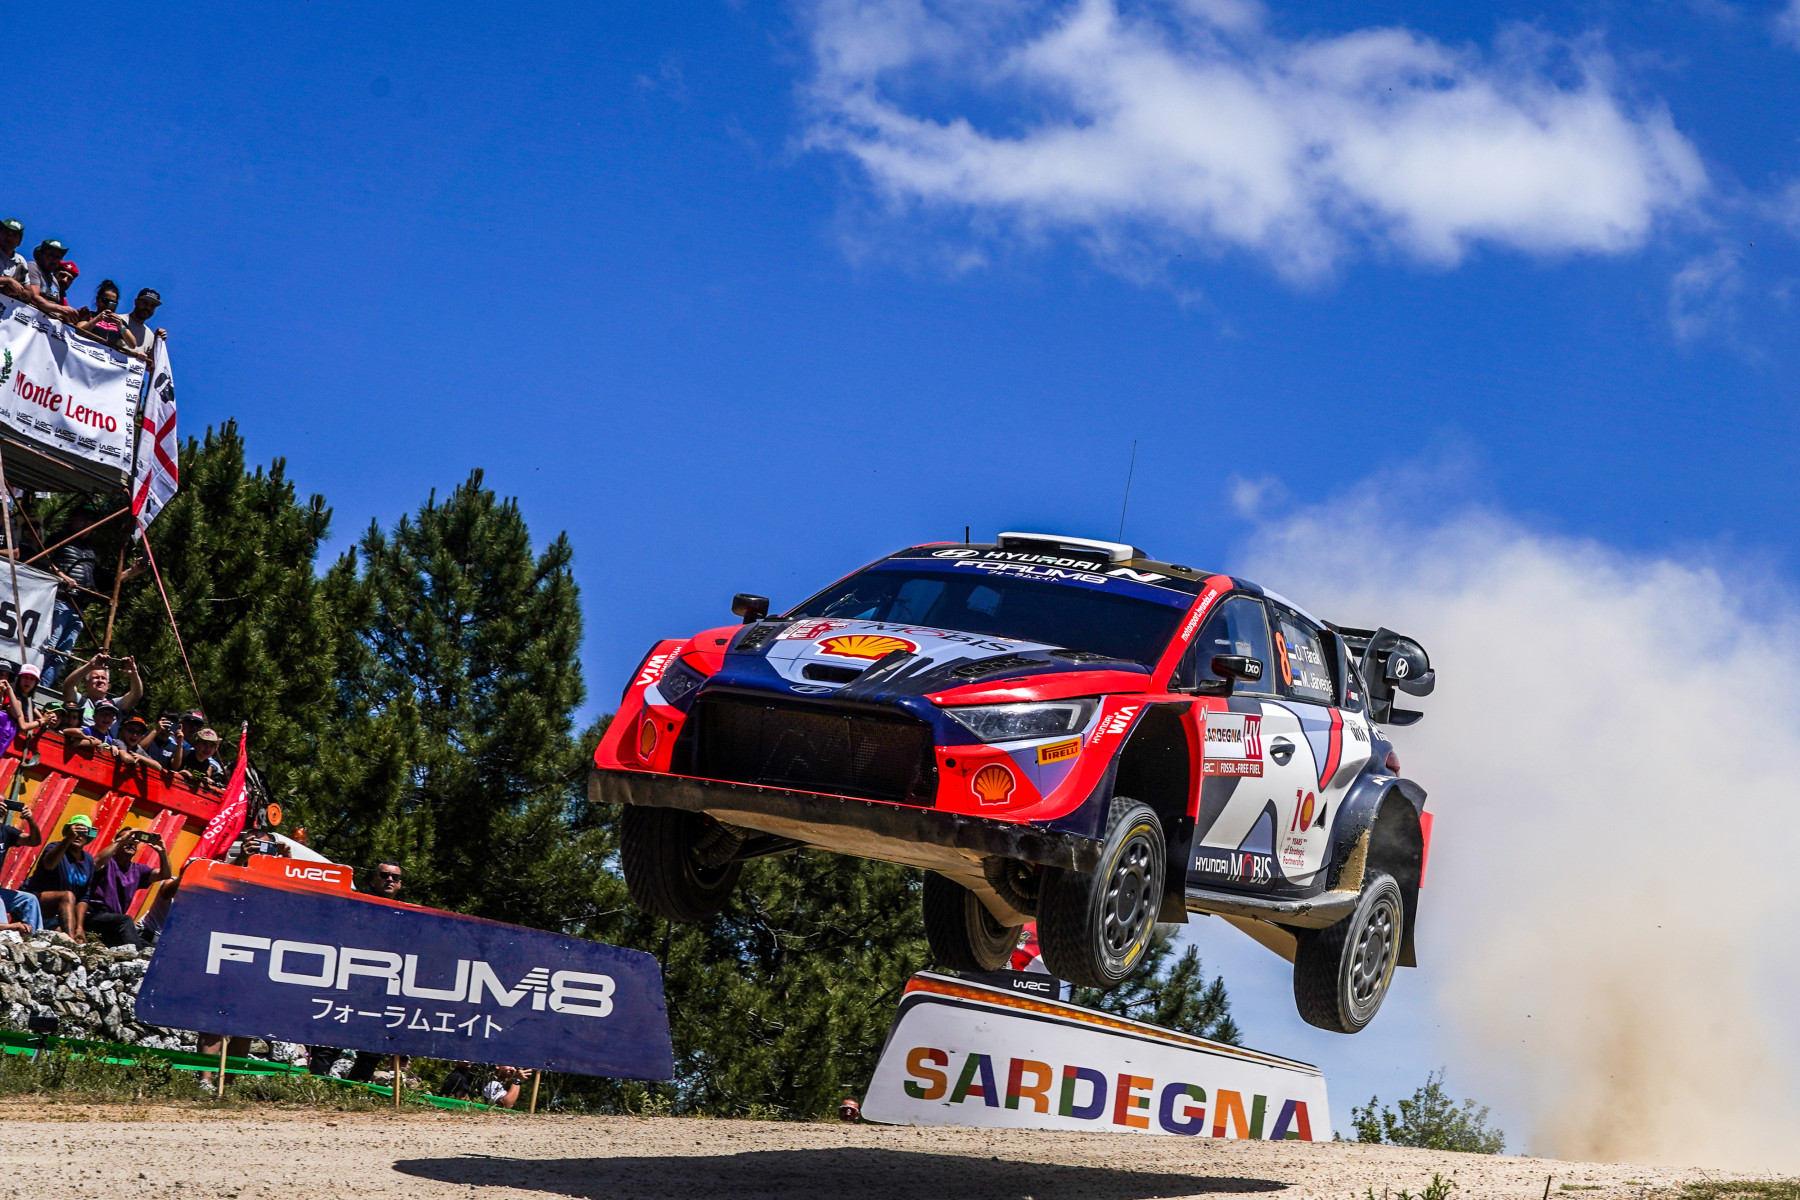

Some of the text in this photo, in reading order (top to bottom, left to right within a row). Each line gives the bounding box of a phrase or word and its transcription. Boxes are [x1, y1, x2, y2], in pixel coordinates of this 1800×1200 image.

[13, 370, 116, 432] Monte Lerno
[55, 427, 77, 440] WRC
[78, 435, 97, 448] WRC
[99, 443, 121, 454] WRC
[953, 560, 1108, 584] FORUM8
[984, 551, 1101, 571] HYUNDAI
[1181, 589, 1218, 641] motorsport.hyundai.com
[1245, 659, 1260, 675] ixo
[1275, 631, 1292, 686] 8
[1092, 715, 1114, 744] HYUNDAI
[1106, 706, 1139, 734] WIA
[1041, 741, 1078, 761] PIRELLI
[1203, 762, 1261, 775] RC FOSSIL-FREE FUEL
[1291, 789, 1315, 833] 10
[285, 865, 341, 883] WRC
[1195, 852, 1272, 885] HYUNDAI MOBIS
[206, 932, 616, 1018] FORUM8
[1013, 979, 1051, 992] WRC
[312, 998, 503, 1039] フォーラムエイト
[904, 1047, 1313, 1142] SARDEGNA
